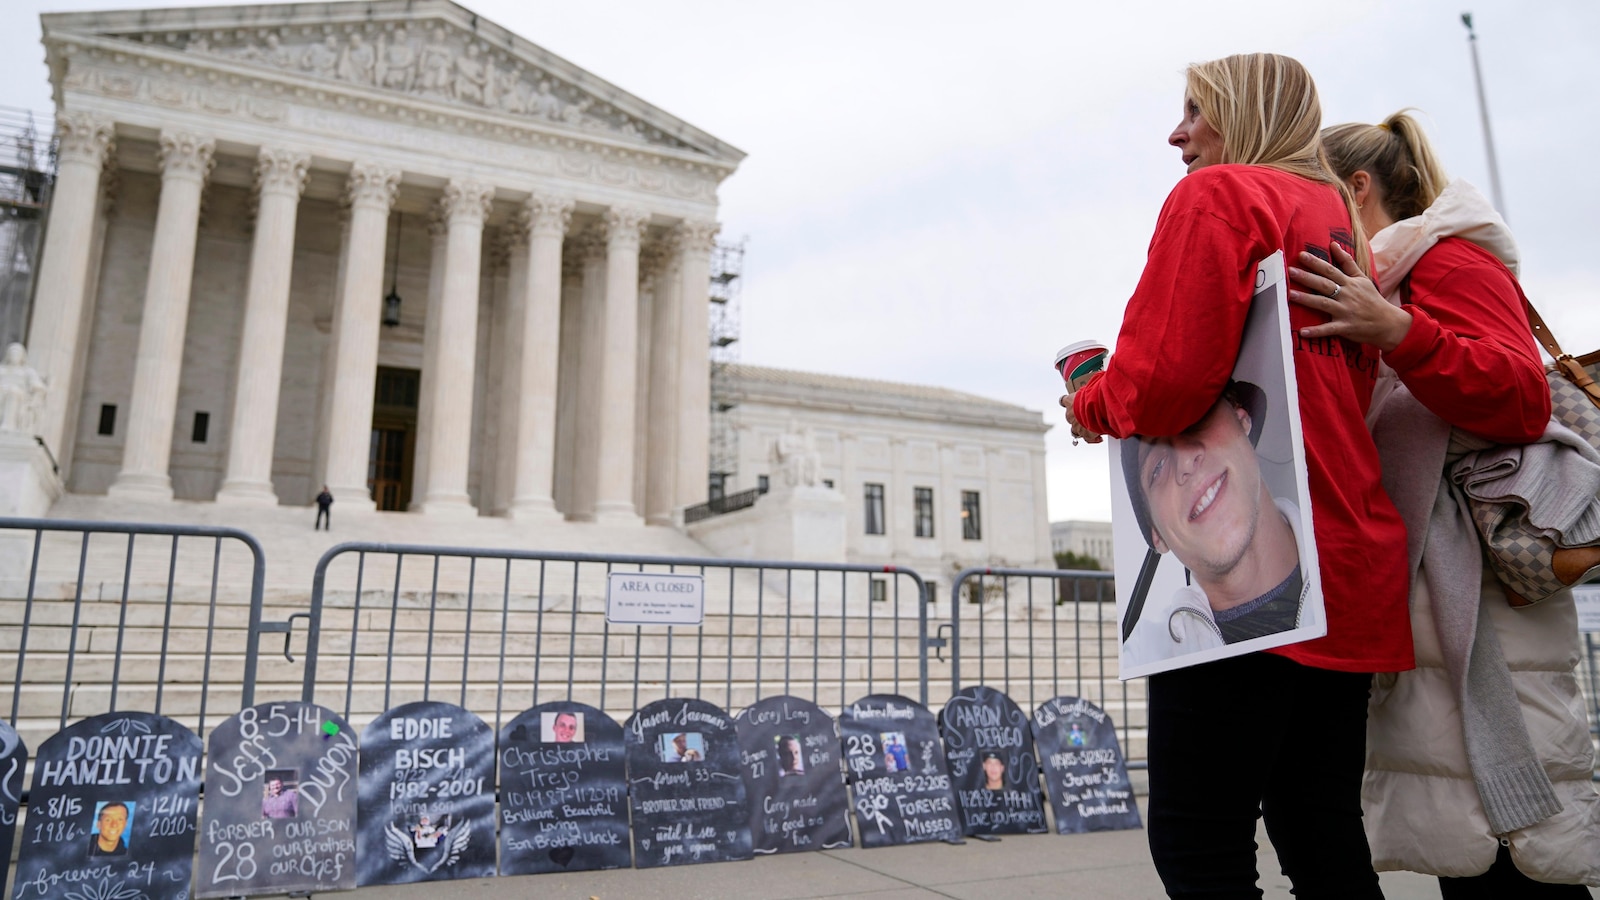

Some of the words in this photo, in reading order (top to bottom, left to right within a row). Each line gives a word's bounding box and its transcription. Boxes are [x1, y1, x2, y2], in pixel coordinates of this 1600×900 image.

[620, 581, 650, 593] AREA
[654, 582, 695, 594] CLOSED
[239, 705, 321, 739] 8-5-14
[631, 710, 671, 744] Jason
[957, 704, 1001, 727] AARON
[390, 717, 453, 741] EDDIE
[66, 734, 172, 761] DONNIE
[503, 743, 612, 769] Christopher
[847, 734, 876, 756] 28
[41, 756, 197, 786] HAMILTON
[395, 748, 465, 770] BISCH
[520, 767, 580, 791] Trejo
[695, 768, 710, 781] 33
[48, 794, 82, 819] 8/15
[152, 793, 190, 817] 12/11
[896, 794, 952, 817] FOREVER
[32, 821, 75, 843] 1986
[317, 819, 350, 835] SON
[127, 861, 156, 885] 24
[212, 842, 257, 884] 28
